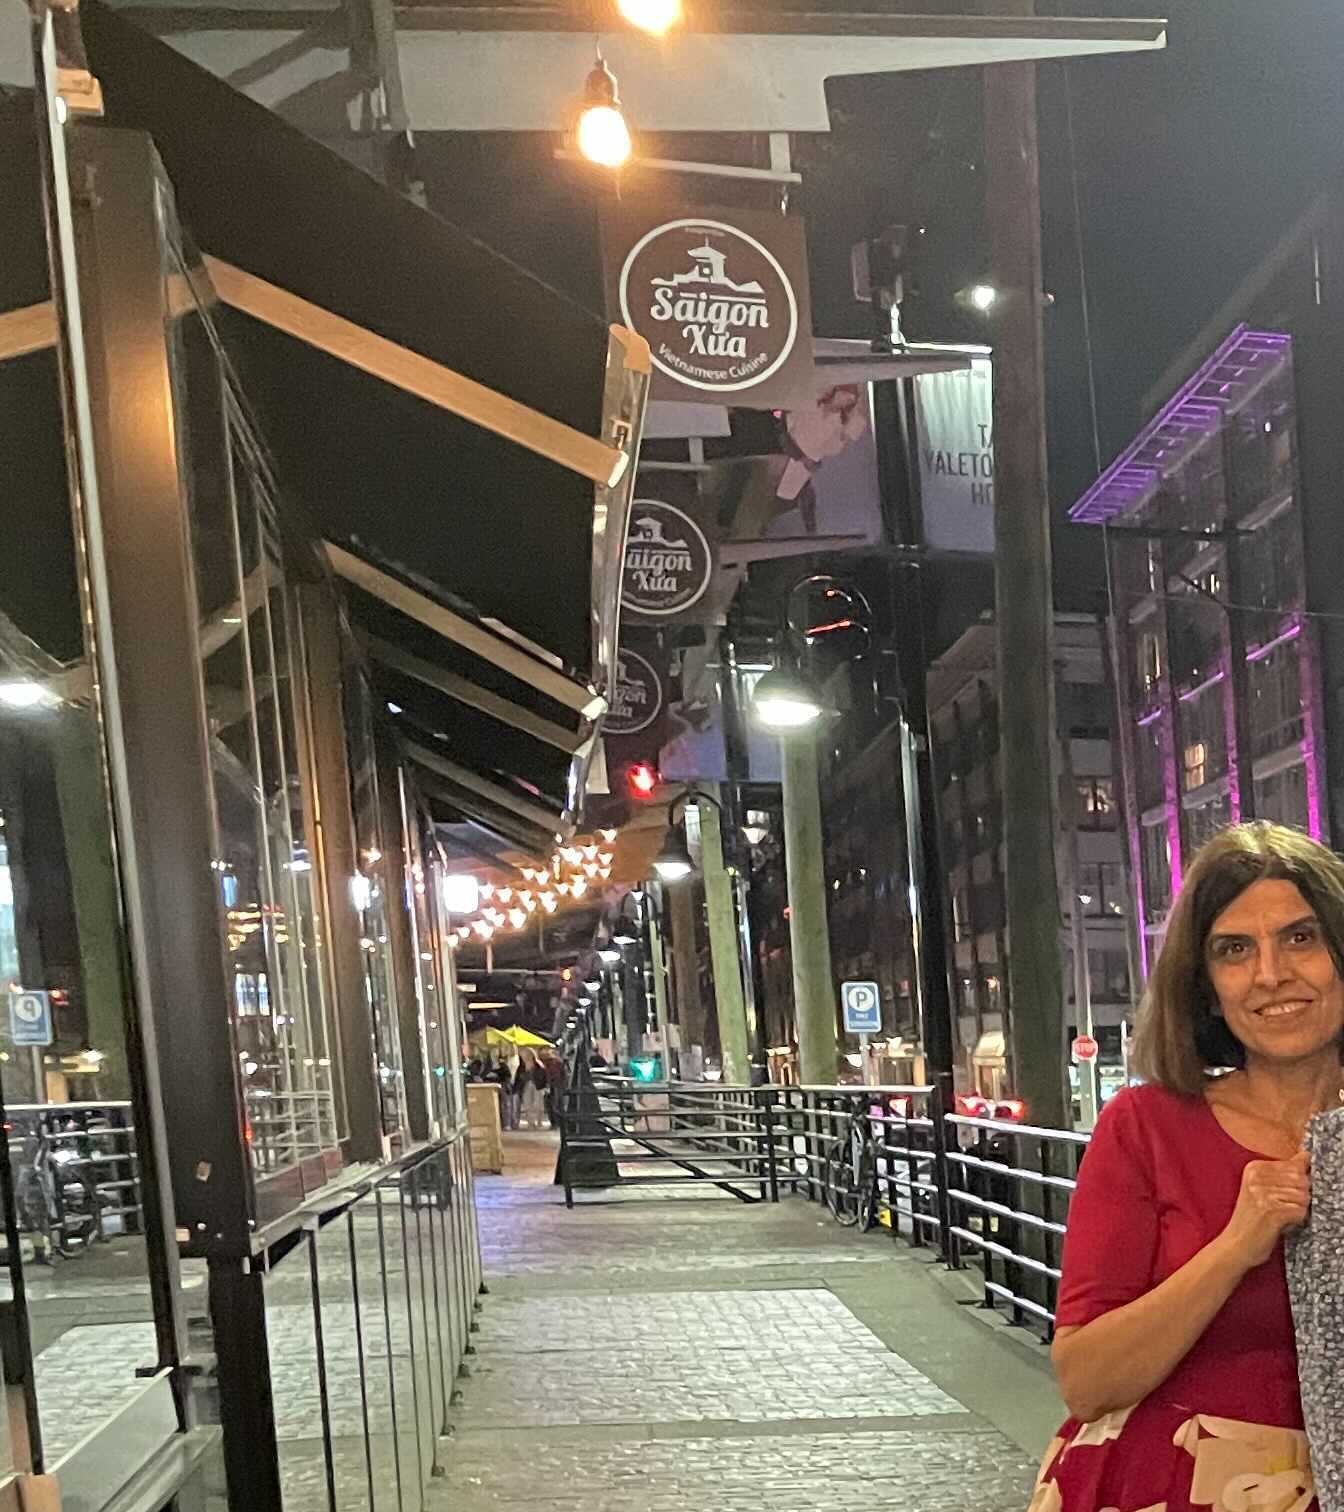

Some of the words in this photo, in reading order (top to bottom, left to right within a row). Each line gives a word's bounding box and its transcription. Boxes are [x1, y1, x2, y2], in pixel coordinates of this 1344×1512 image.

[650, 287, 769, 334] Saigon
[659, 343, 728, 380] Vietnamese
[728, 353, 768, 379] Cuisine
[924, 451, 992, 478] YALETO
[624, 549, 693, 577] aigon
